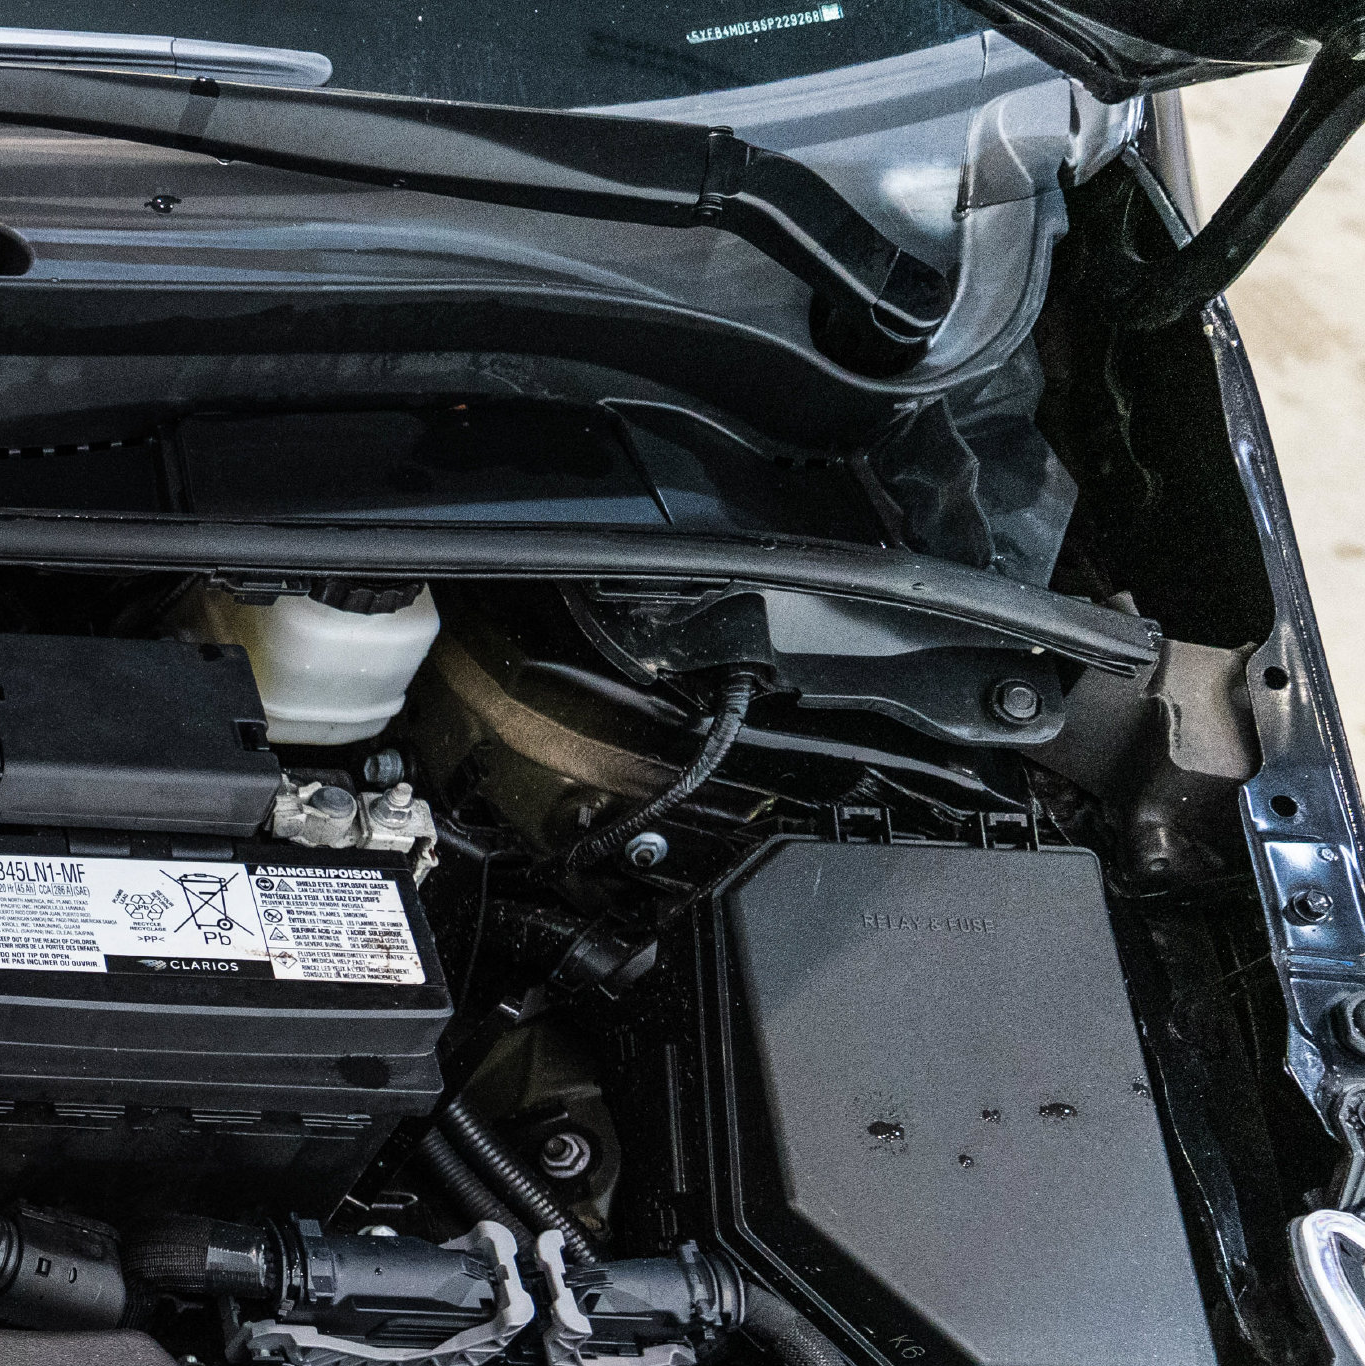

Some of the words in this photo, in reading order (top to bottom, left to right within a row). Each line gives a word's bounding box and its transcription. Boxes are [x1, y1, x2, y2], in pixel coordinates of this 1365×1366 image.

[267, 866, 382, 879] DANGER/POISON
[24, 884, 33, 893] Ah
[38, 884, 51, 894] CCA
[72, 886, 90, 896] (SAE)
[259, 891, 290, 899] PROTÉGEZ
[862, 913, 919, 931] RELAY
[929, 917, 942, 932] &
[947, 918, 996, 934] FUSE
[203, 931, 232, 946] Pb
[170, 960, 239, 971] CLARIOS
